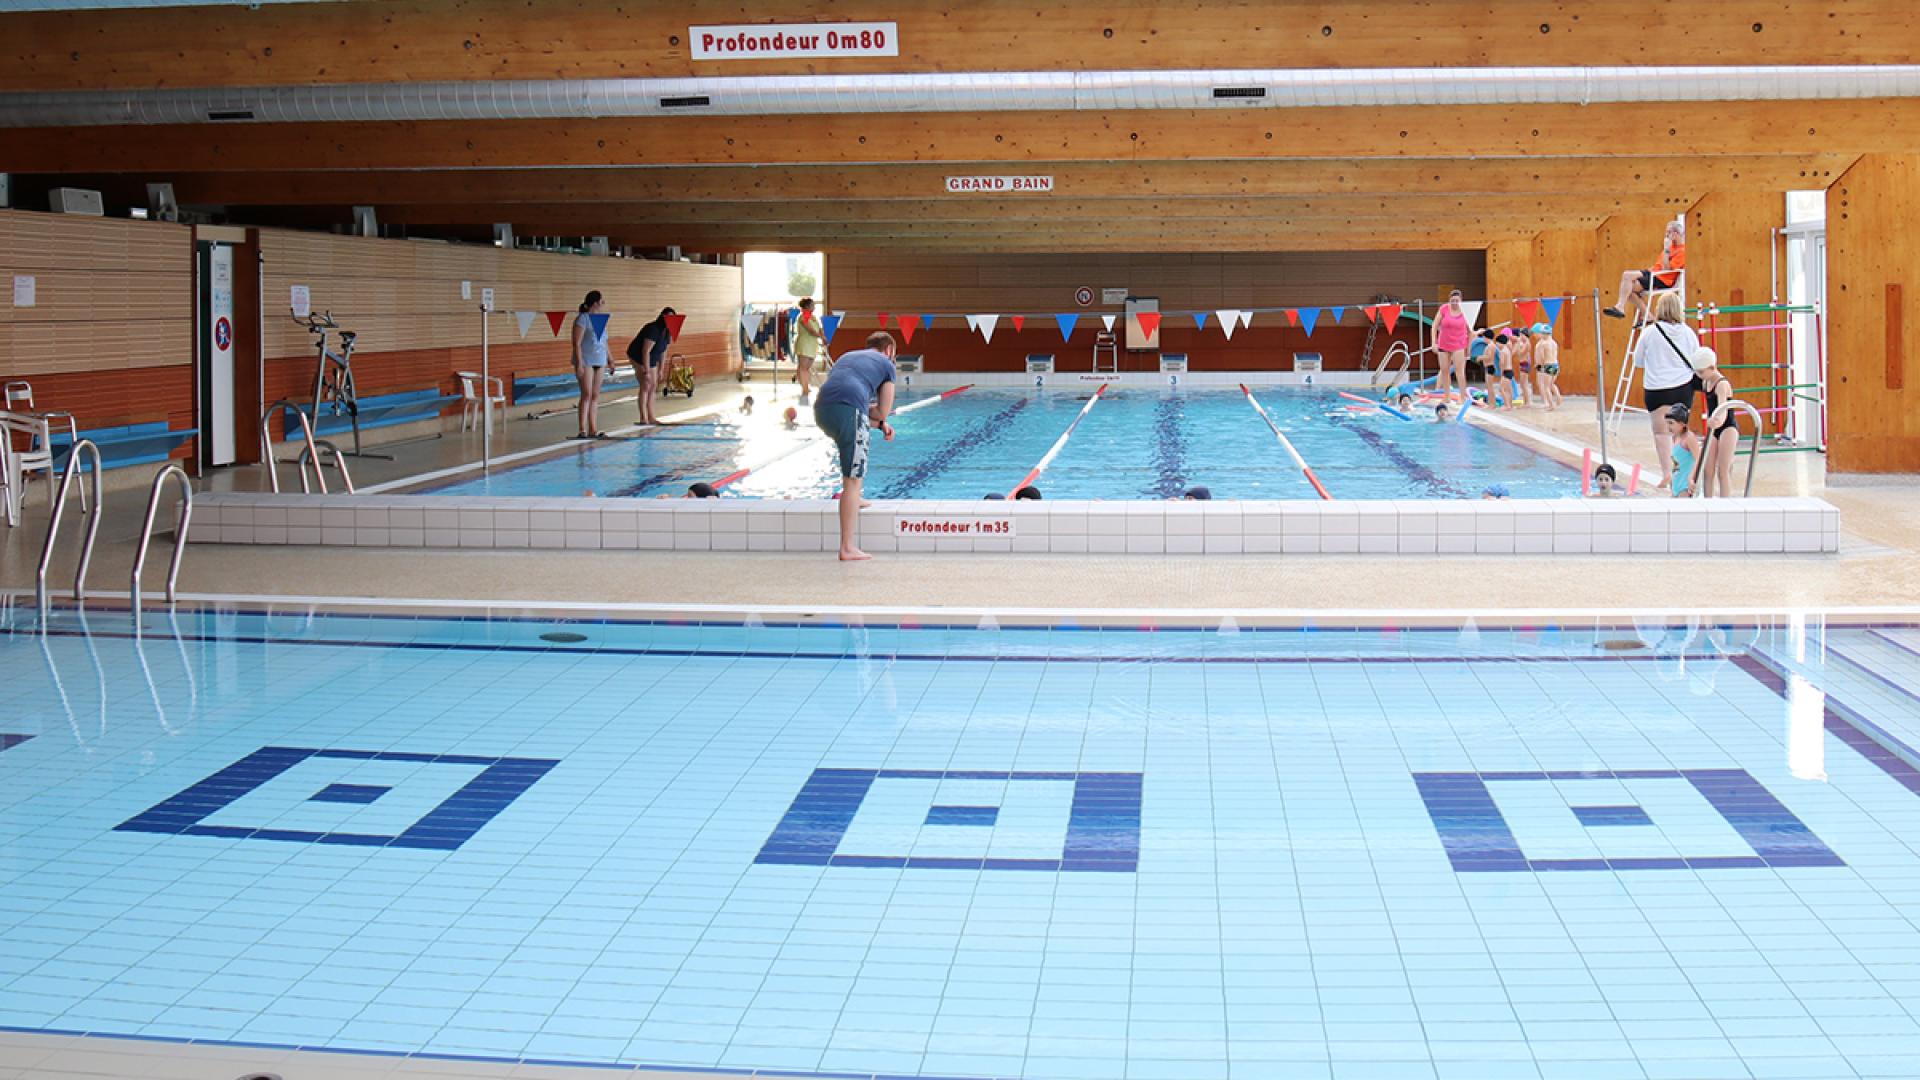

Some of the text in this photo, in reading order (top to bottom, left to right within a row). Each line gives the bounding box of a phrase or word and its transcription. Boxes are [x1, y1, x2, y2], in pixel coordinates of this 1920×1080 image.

[702, 30, 886, 52] Profondeur 0m80
[950, 178, 1049, 189] GRAND BAIN
[1035, 375, 1043, 386] 2
[1170, 375, 1177, 385] 3
[1305, 375, 1313, 384] 4
[901, 520, 1009, 533] Profondeur 1m35
